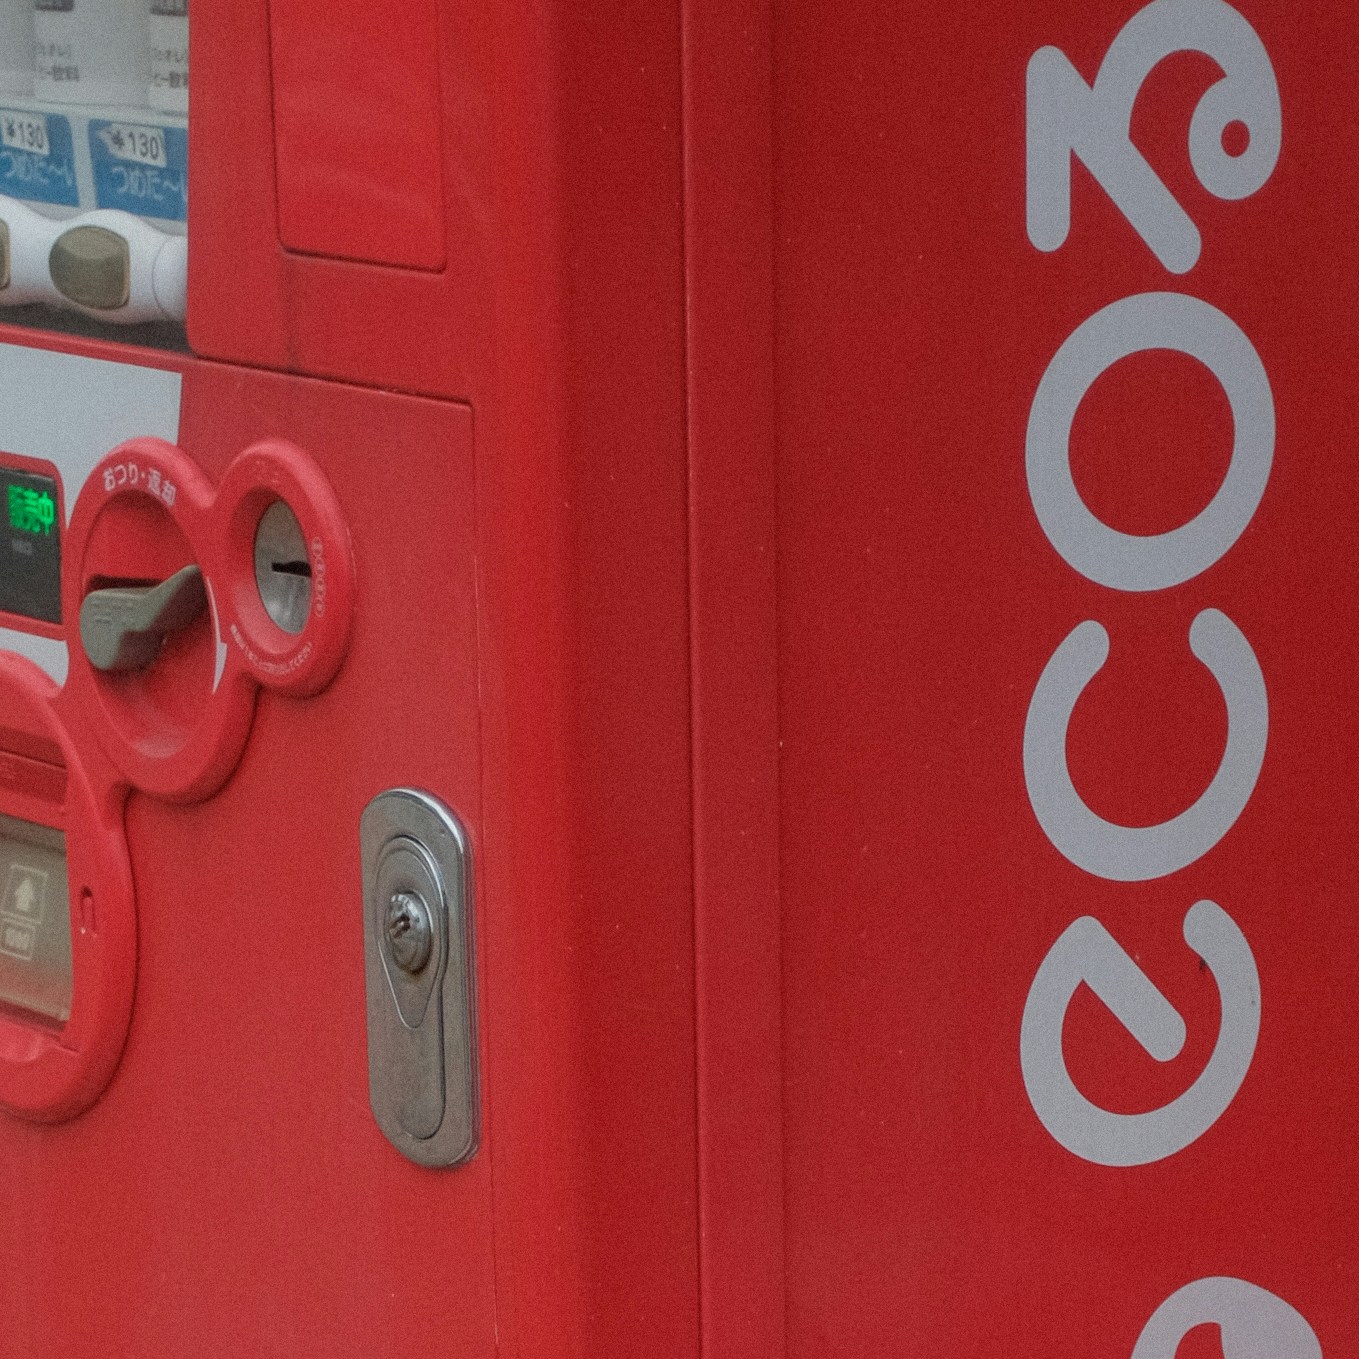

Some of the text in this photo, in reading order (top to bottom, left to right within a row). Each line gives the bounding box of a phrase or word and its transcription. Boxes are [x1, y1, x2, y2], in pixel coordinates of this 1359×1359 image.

[110, 129, 159, 160] ¥130
[102, 460, 177, 506] おつり・返却
